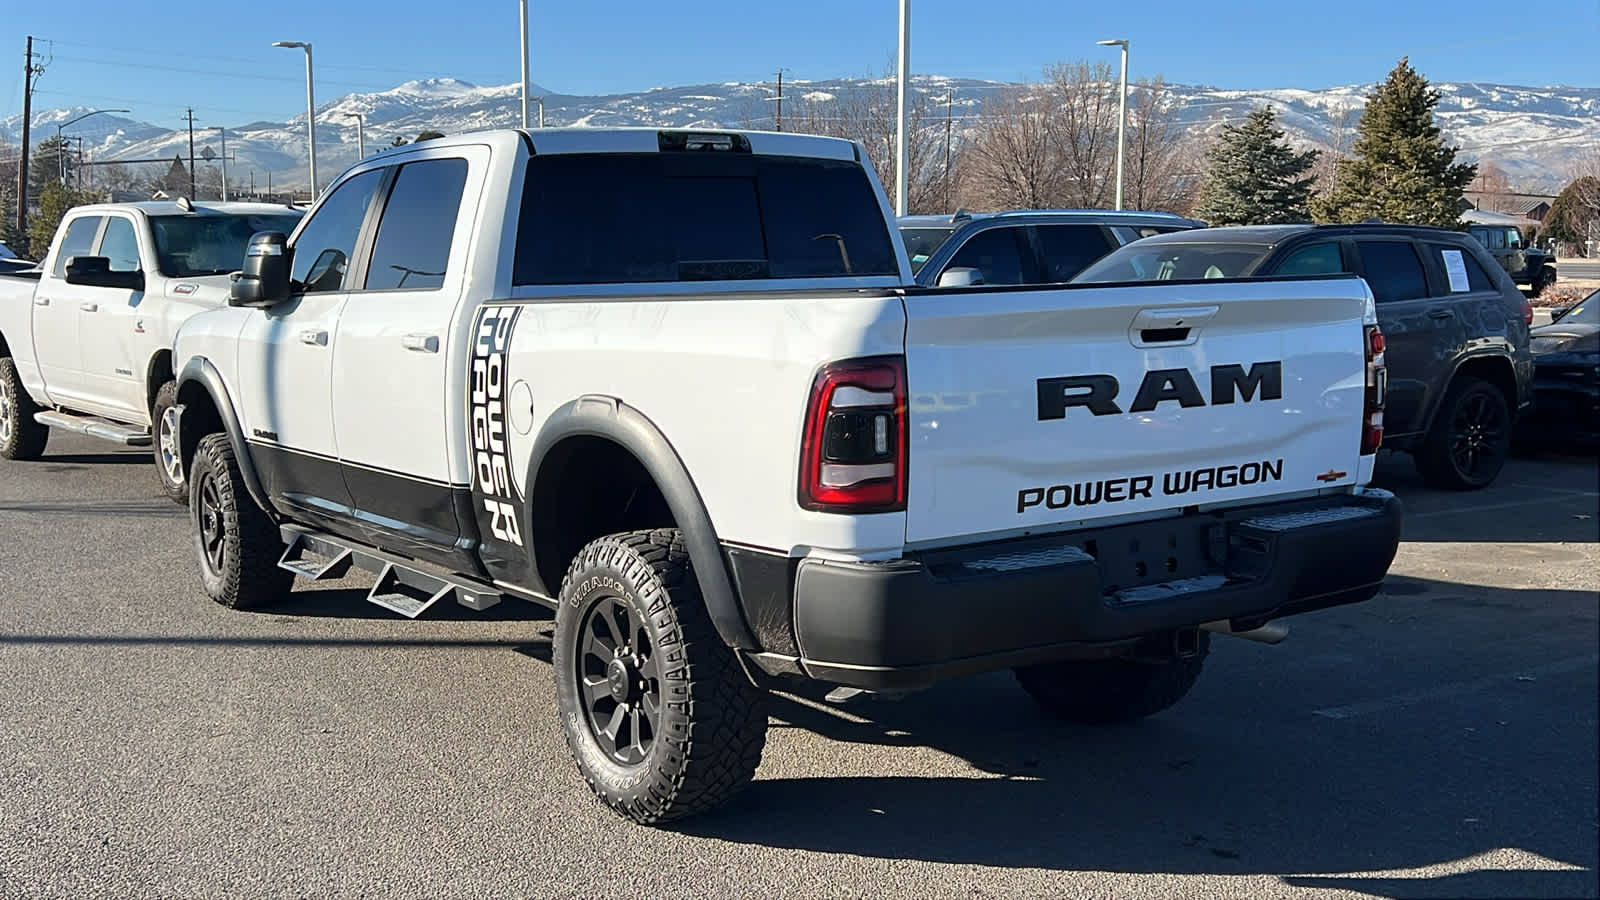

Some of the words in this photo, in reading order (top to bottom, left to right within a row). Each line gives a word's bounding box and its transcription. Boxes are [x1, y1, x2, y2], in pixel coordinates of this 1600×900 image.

[473, 307, 510, 541] WAGON
[487, 307, 523, 546] POWER
[1036, 361, 1282, 421] RAM
[1017, 475, 1154, 513] POWER
[1163, 459, 1283, 496] WAGON
